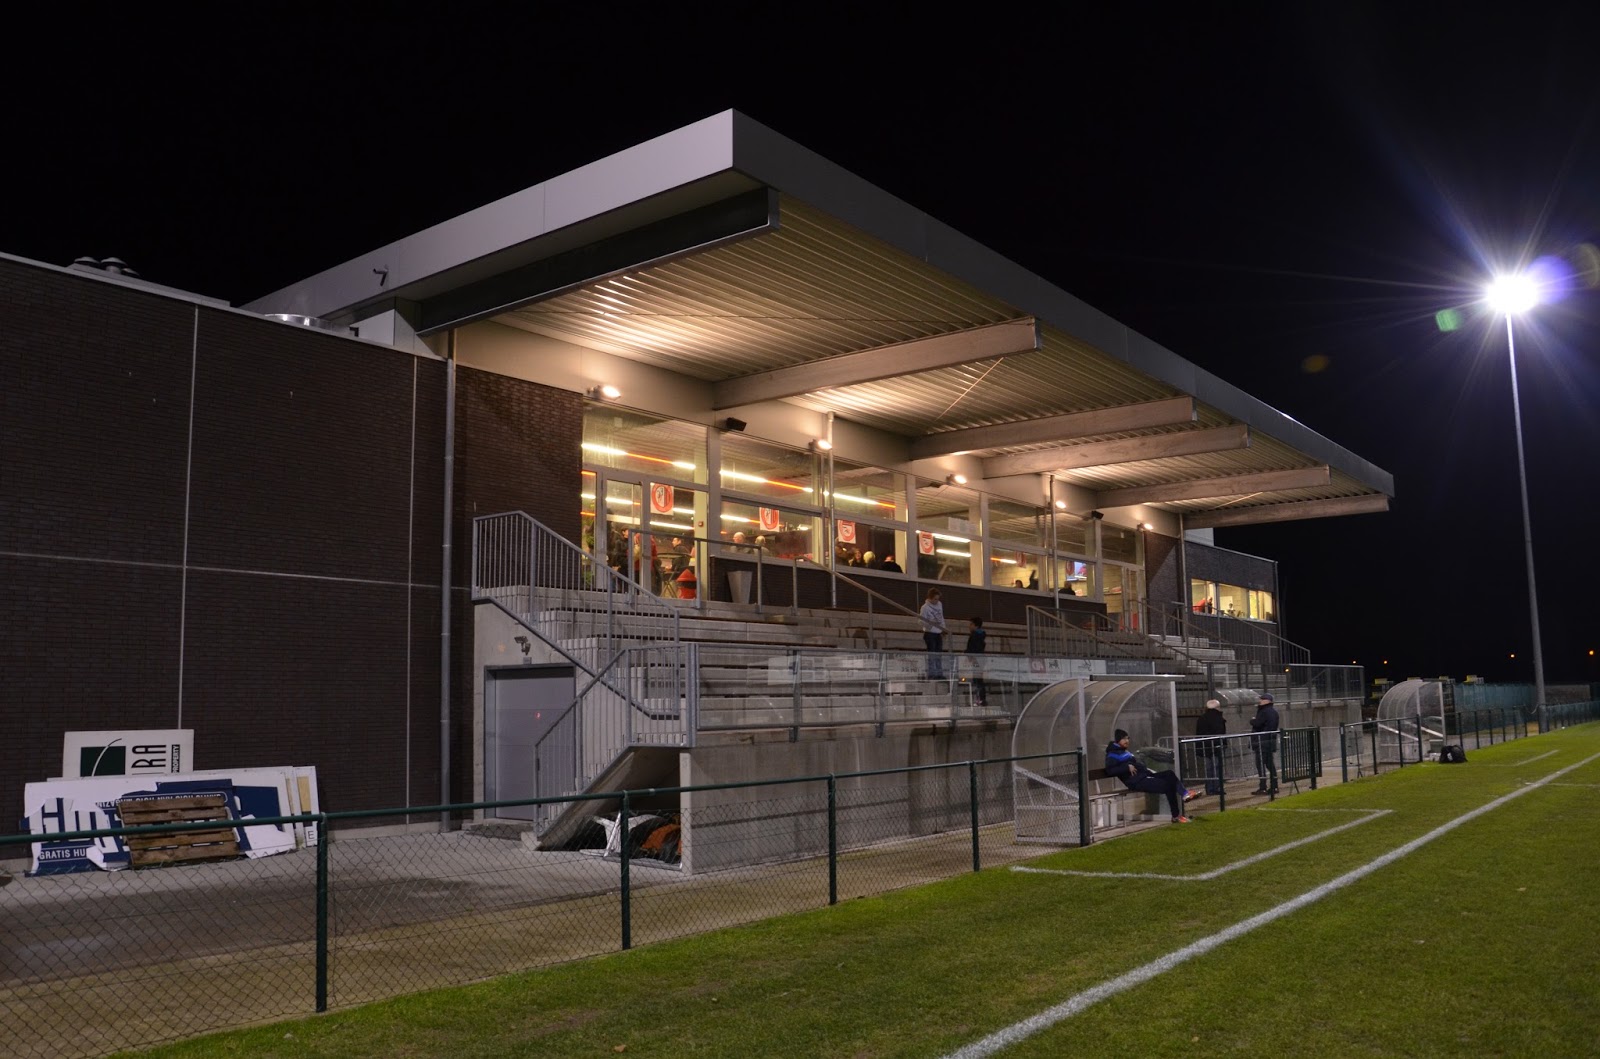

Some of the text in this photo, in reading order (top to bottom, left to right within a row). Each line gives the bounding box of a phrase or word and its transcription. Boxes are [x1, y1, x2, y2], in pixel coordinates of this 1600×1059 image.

[131, 744, 166, 775] RA
[171, 745, 180, 774] PROPERTY
[39, 847, 71, 860] GRATIS
